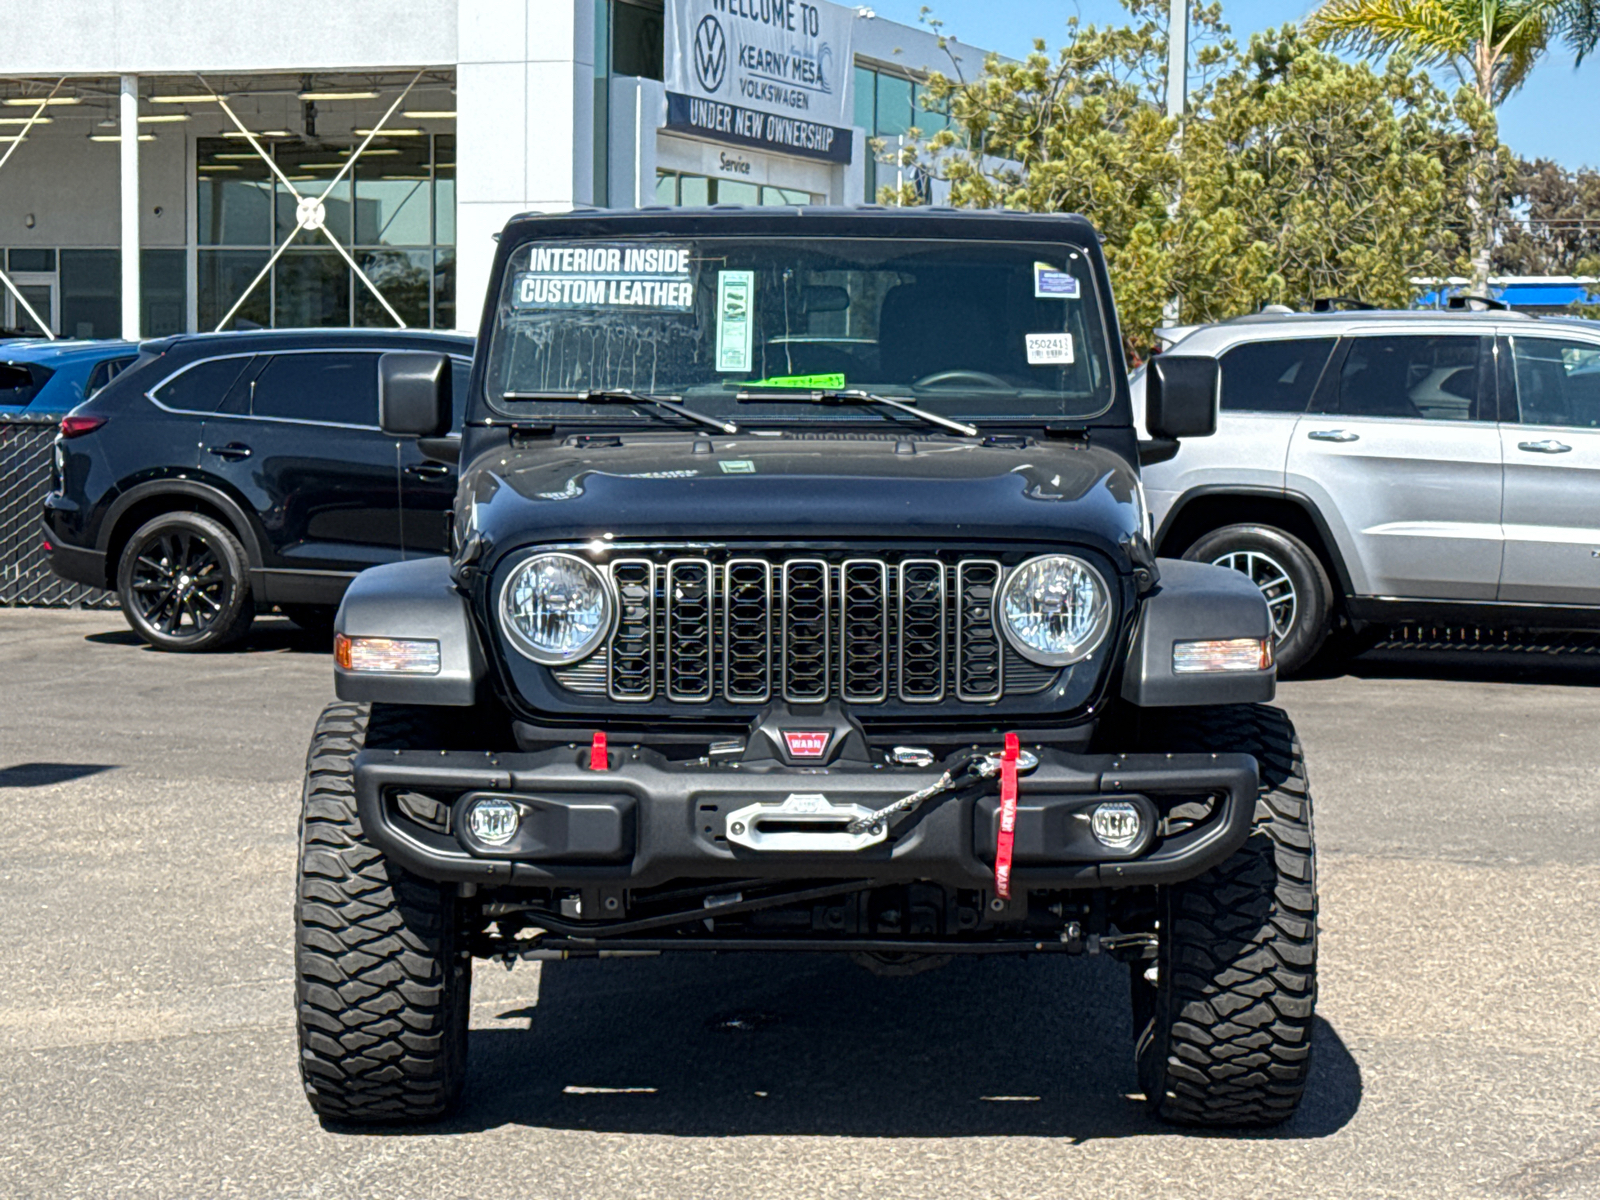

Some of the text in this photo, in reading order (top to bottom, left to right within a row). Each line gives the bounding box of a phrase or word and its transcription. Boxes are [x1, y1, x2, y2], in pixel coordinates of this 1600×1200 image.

[800, 2, 819, 38] TO
[739, 42, 824, 85] KEARNY MESA
[739, 78, 809, 110] VOLKSWAGEN
[689, 98, 834, 152] UNDER NEW OWNERSHIP
[719, 151, 751, 175] Service
[530, 248, 689, 273] INTERIOR INSIDE
[520, 279, 693, 306] CUSTOM LEATHER
[791, 739, 821, 748] WARN
[1001, 799, 1014, 832] WARN
[997, 865, 1009, 896] WARN
